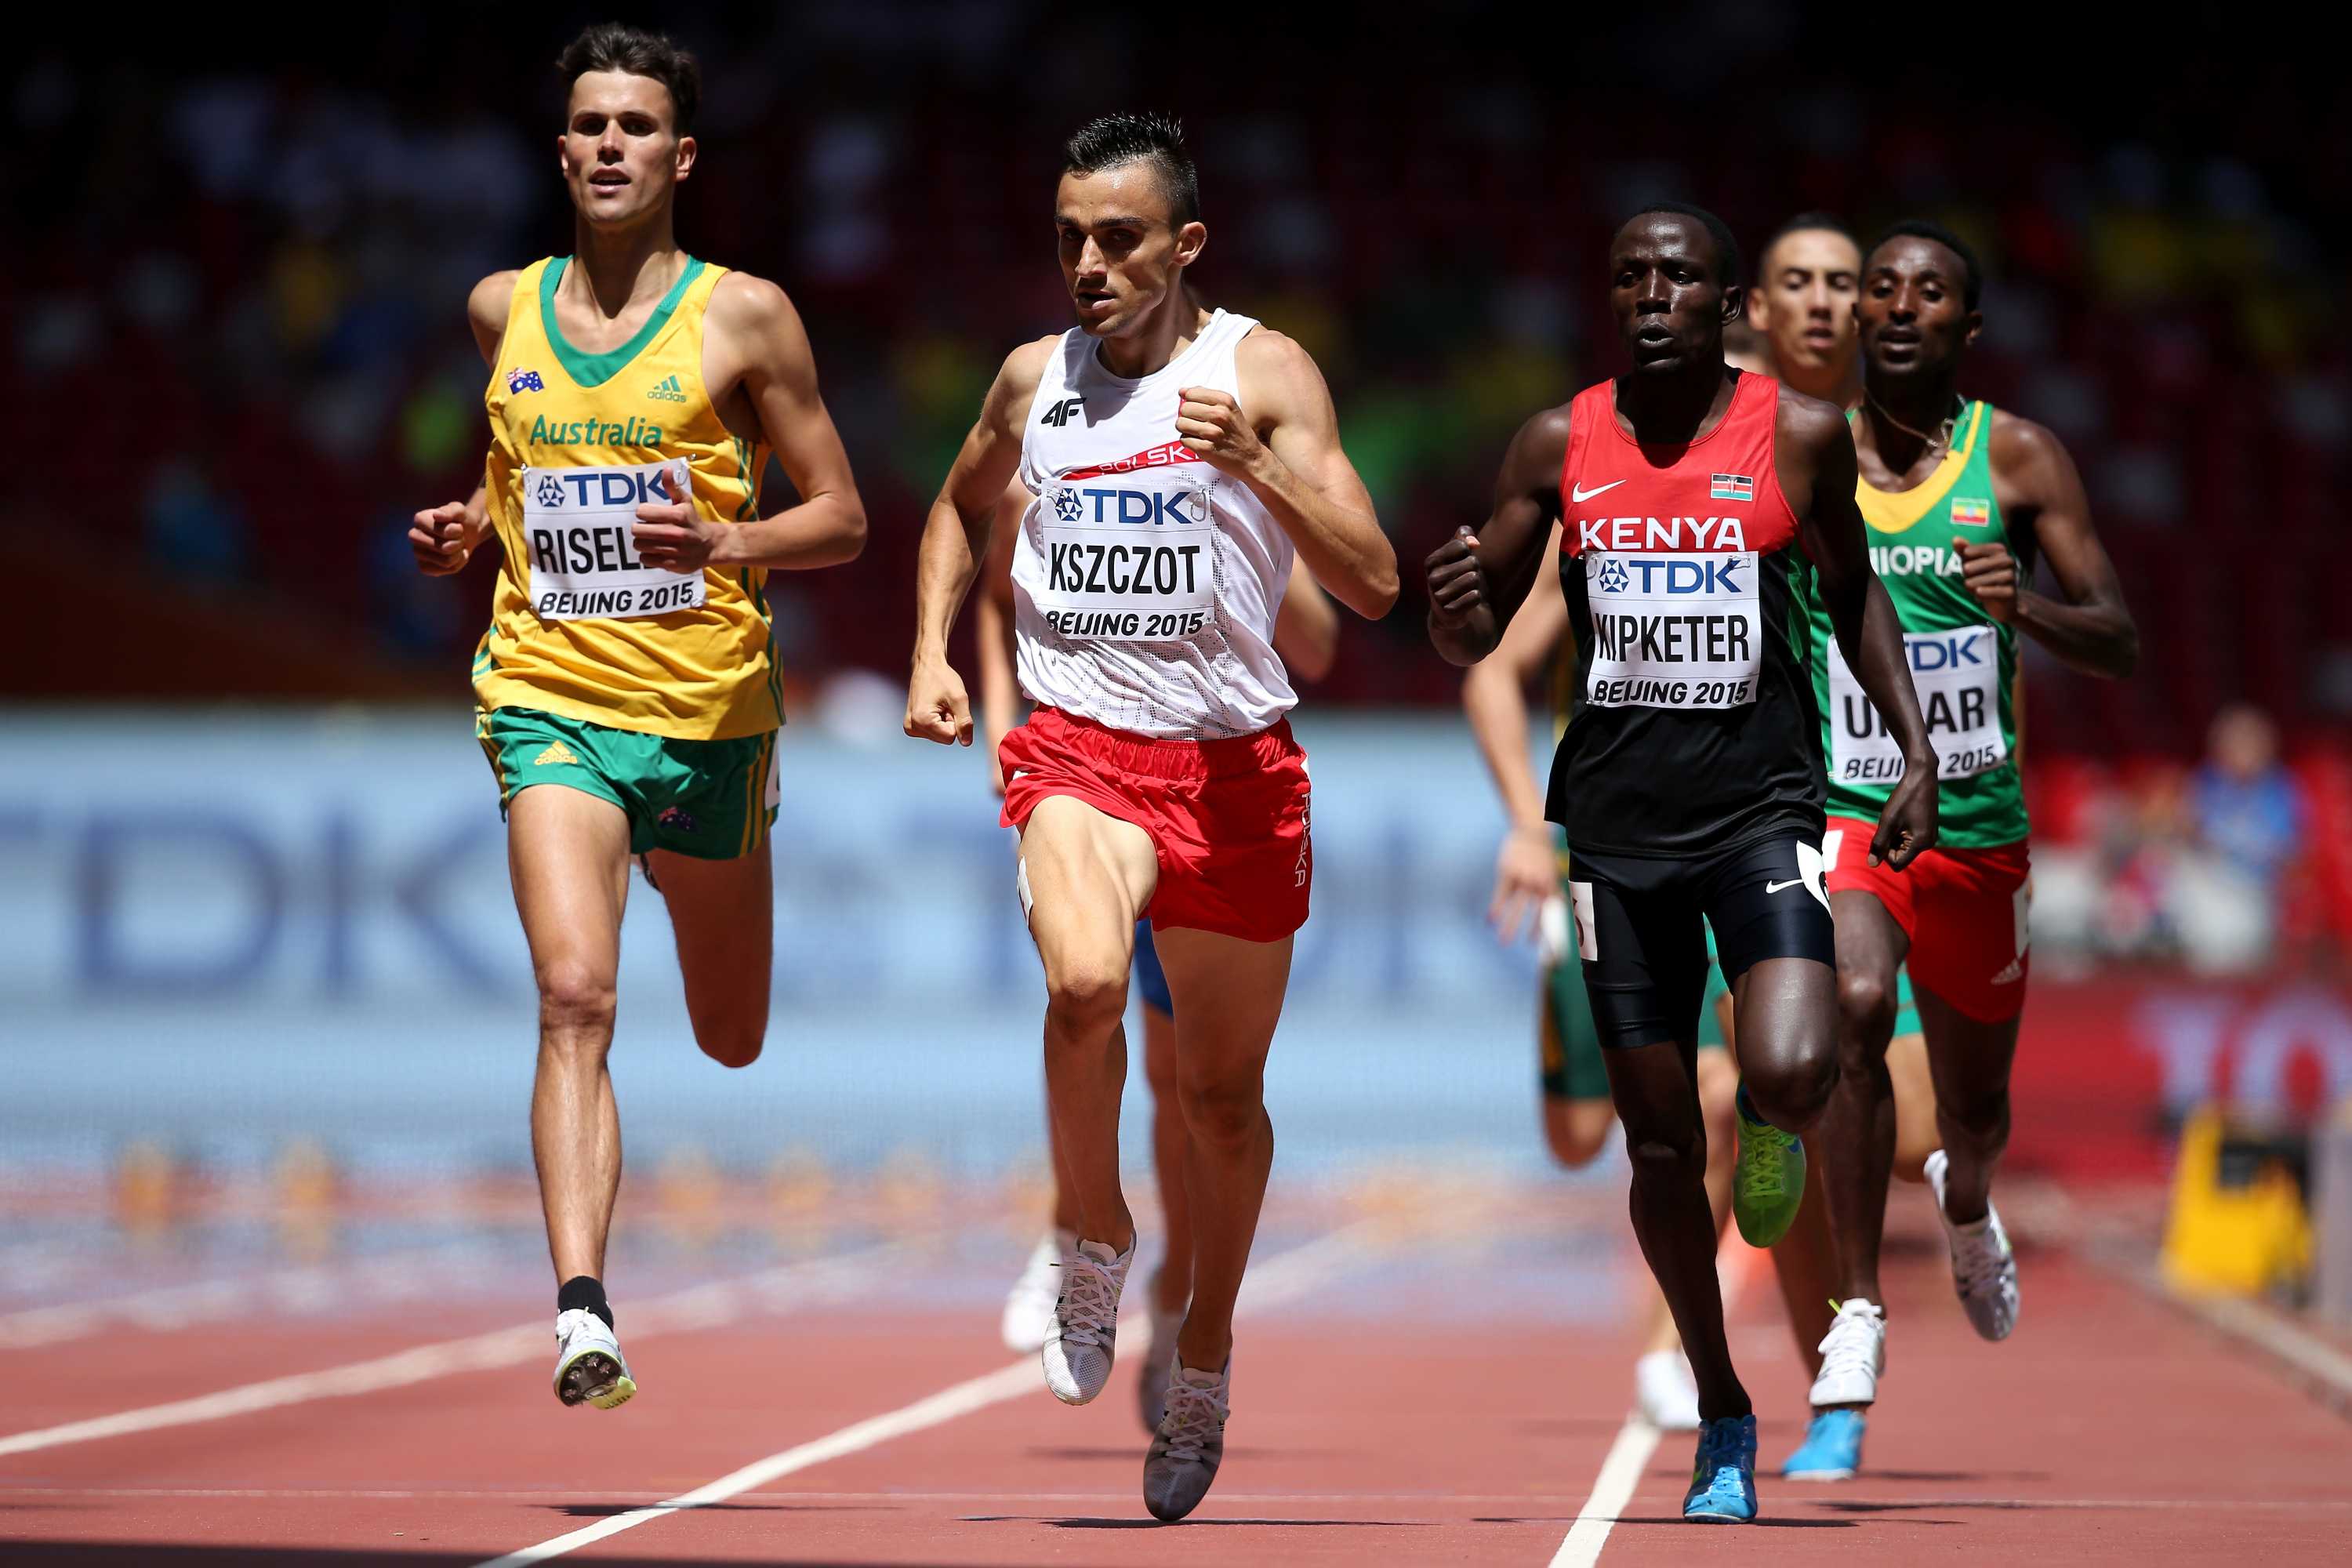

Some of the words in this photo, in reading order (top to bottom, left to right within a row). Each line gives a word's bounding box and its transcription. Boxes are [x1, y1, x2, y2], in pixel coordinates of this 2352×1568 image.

[647, 390, 687, 403] adidas
[1041, 397, 1087, 427] 4F
[530, 415, 662, 448] Australia
[1099, 445, 1201, 473] POLSK
[564, 470, 672, 506] TDK
[1083, 488, 1192, 525] TDK
[532, 526, 654, 575] RISEL
[1579, 517, 1746, 551] KENYA
[1049, 543, 1200, 595] KSZCZOT
[1628, 560, 1743, 593] TDK
[1870, 545, 1963, 577] IOPIA
[539, 591, 632, 614] BEIJING
[639, 582, 695, 611] 2015
[1046, 610, 1139, 636] BEIJING
[1144, 612, 1205, 637] 2015
[1595, 612, 1750, 662] KIPKETER
[1904, 634, 1982, 670] DK
[1593, 680, 1688, 704] BEIJING
[1693, 680, 1751, 704] 2015
[1843, 686, 1986, 739] UAR
[1844, 757, 1903, 779] BEIJI
[1946, 745, 1996, 773] 2015
